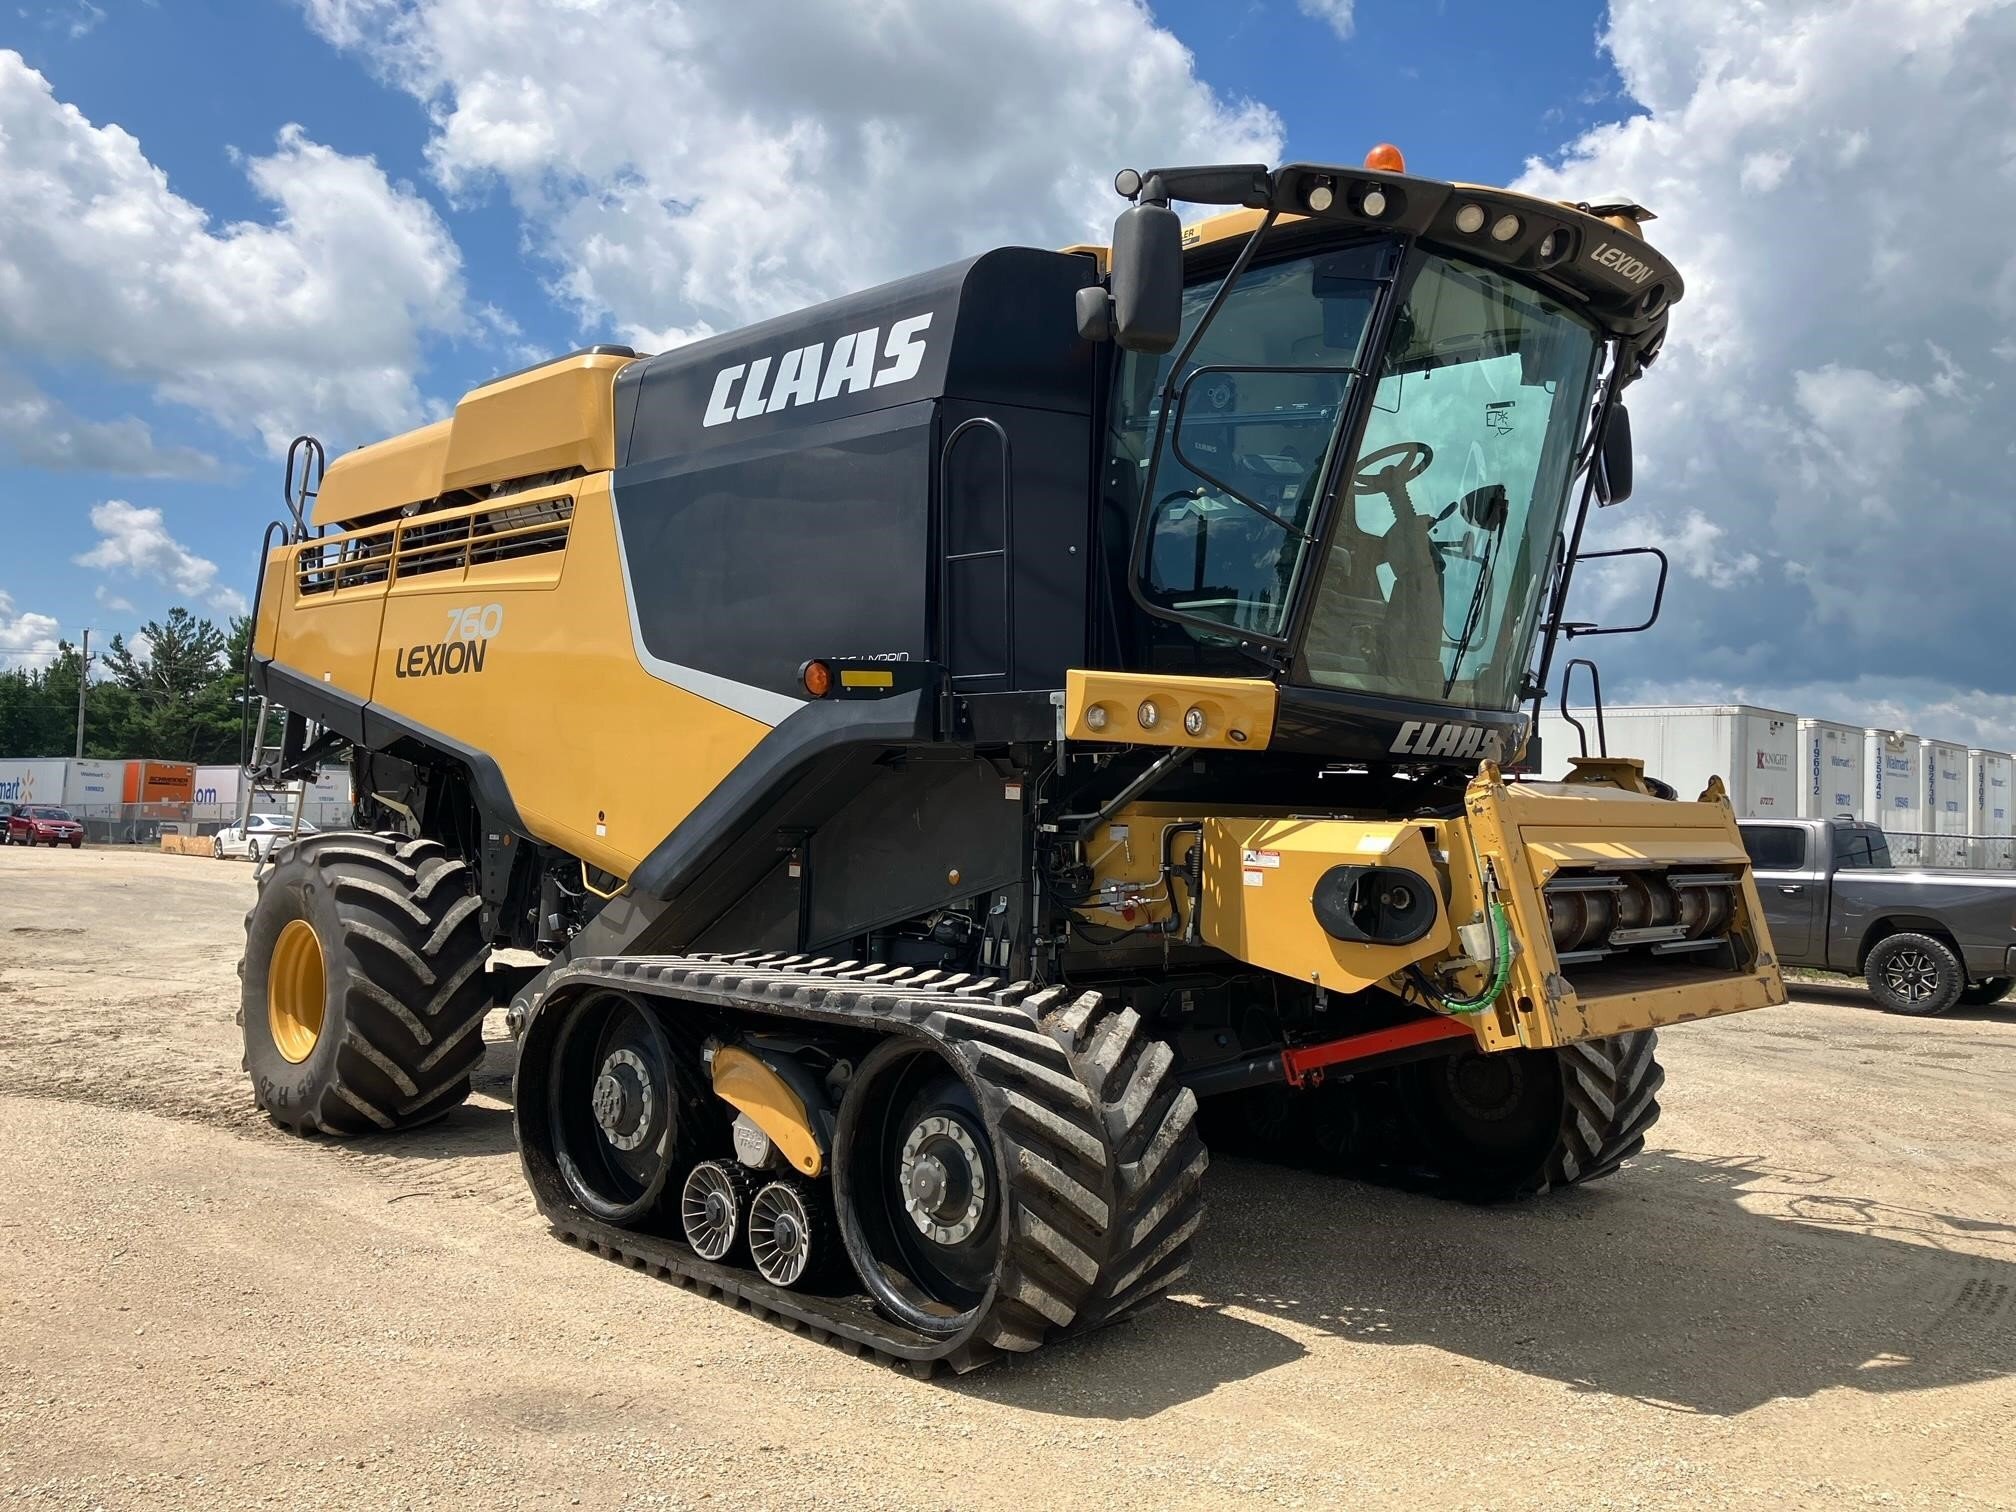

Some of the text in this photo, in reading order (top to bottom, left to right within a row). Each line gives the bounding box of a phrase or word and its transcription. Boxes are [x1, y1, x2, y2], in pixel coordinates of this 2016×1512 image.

[1590, 242, 1655, 284] LEXION
[702, 311, 934, 428] CLAAS
[443, 602, 503, 642] 760
[395, 638, 488, 678] LEXION
[1388, 720, 1499, 760] CLAAS
[1886, 755, 1909, 771] Walmart
